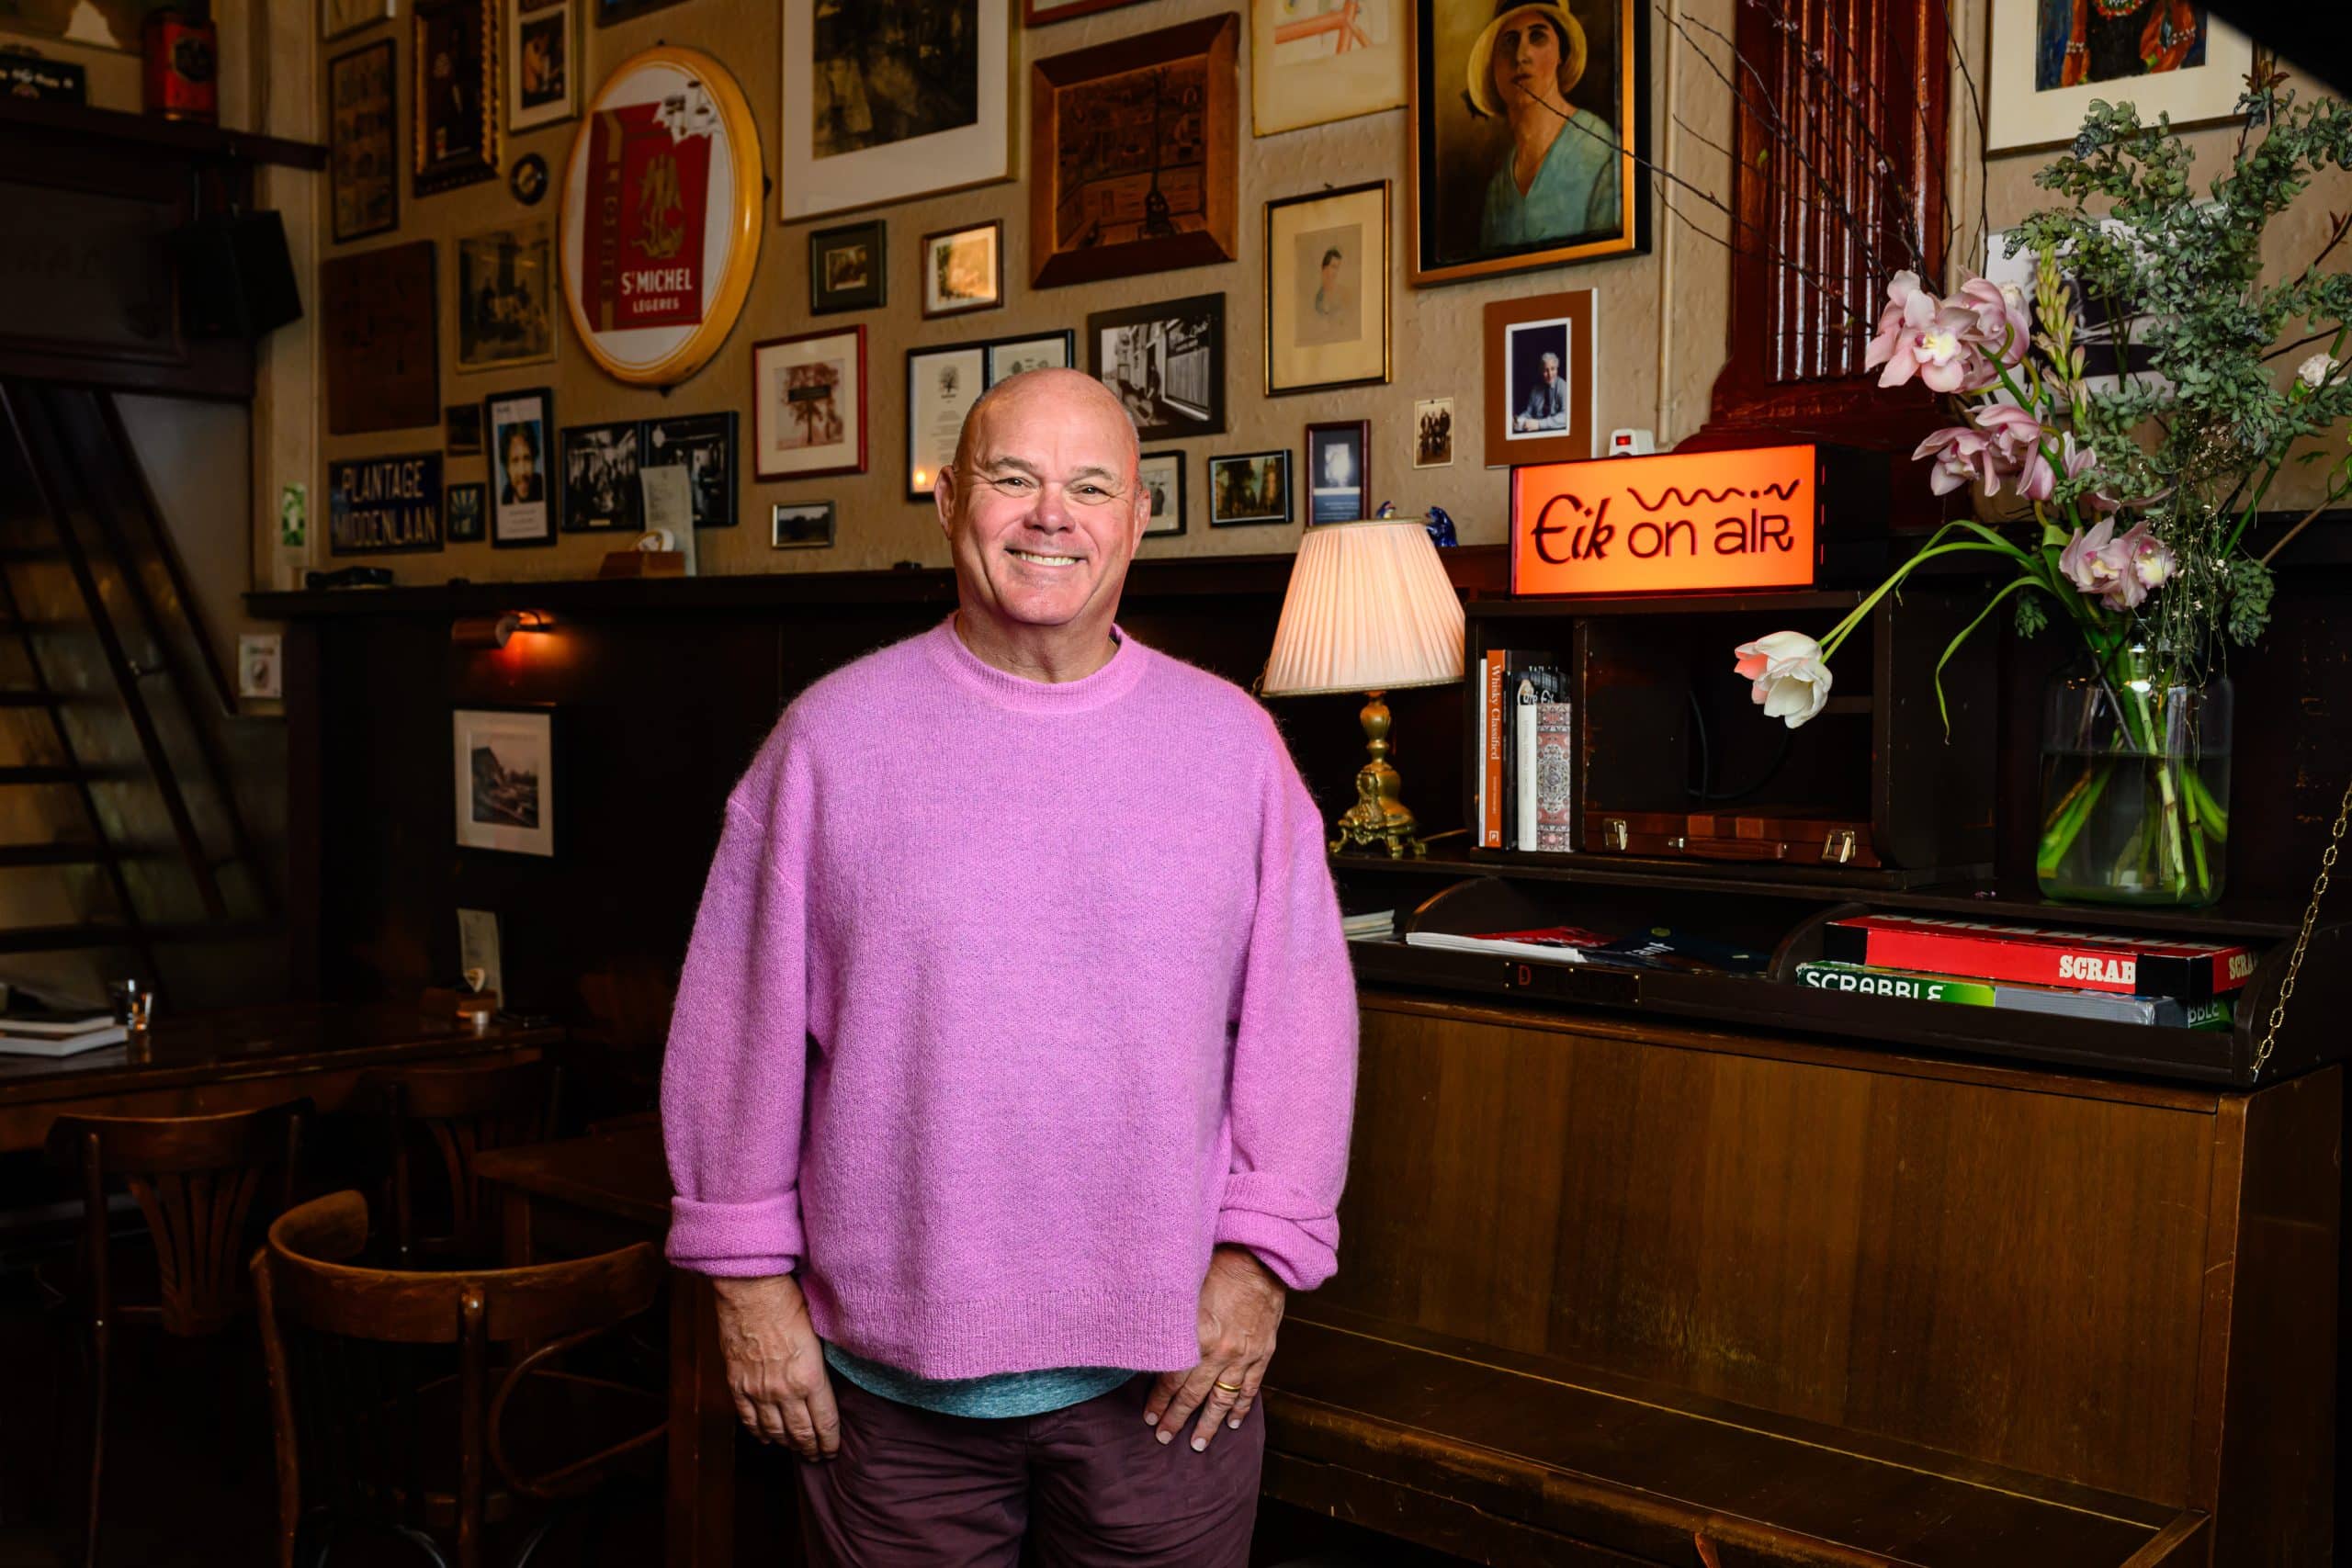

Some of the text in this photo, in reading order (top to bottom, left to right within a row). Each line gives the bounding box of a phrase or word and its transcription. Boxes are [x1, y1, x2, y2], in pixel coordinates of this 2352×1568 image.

[341, 460, 425, 502] PLANTAGE
[331, 506, 437, 548] MIDDENLAAN
[1531, 493, 1615, 565] Eik
[1627, 519, 1698, 558] on
[1490, 664, 1501, 761] Whisky Classified
